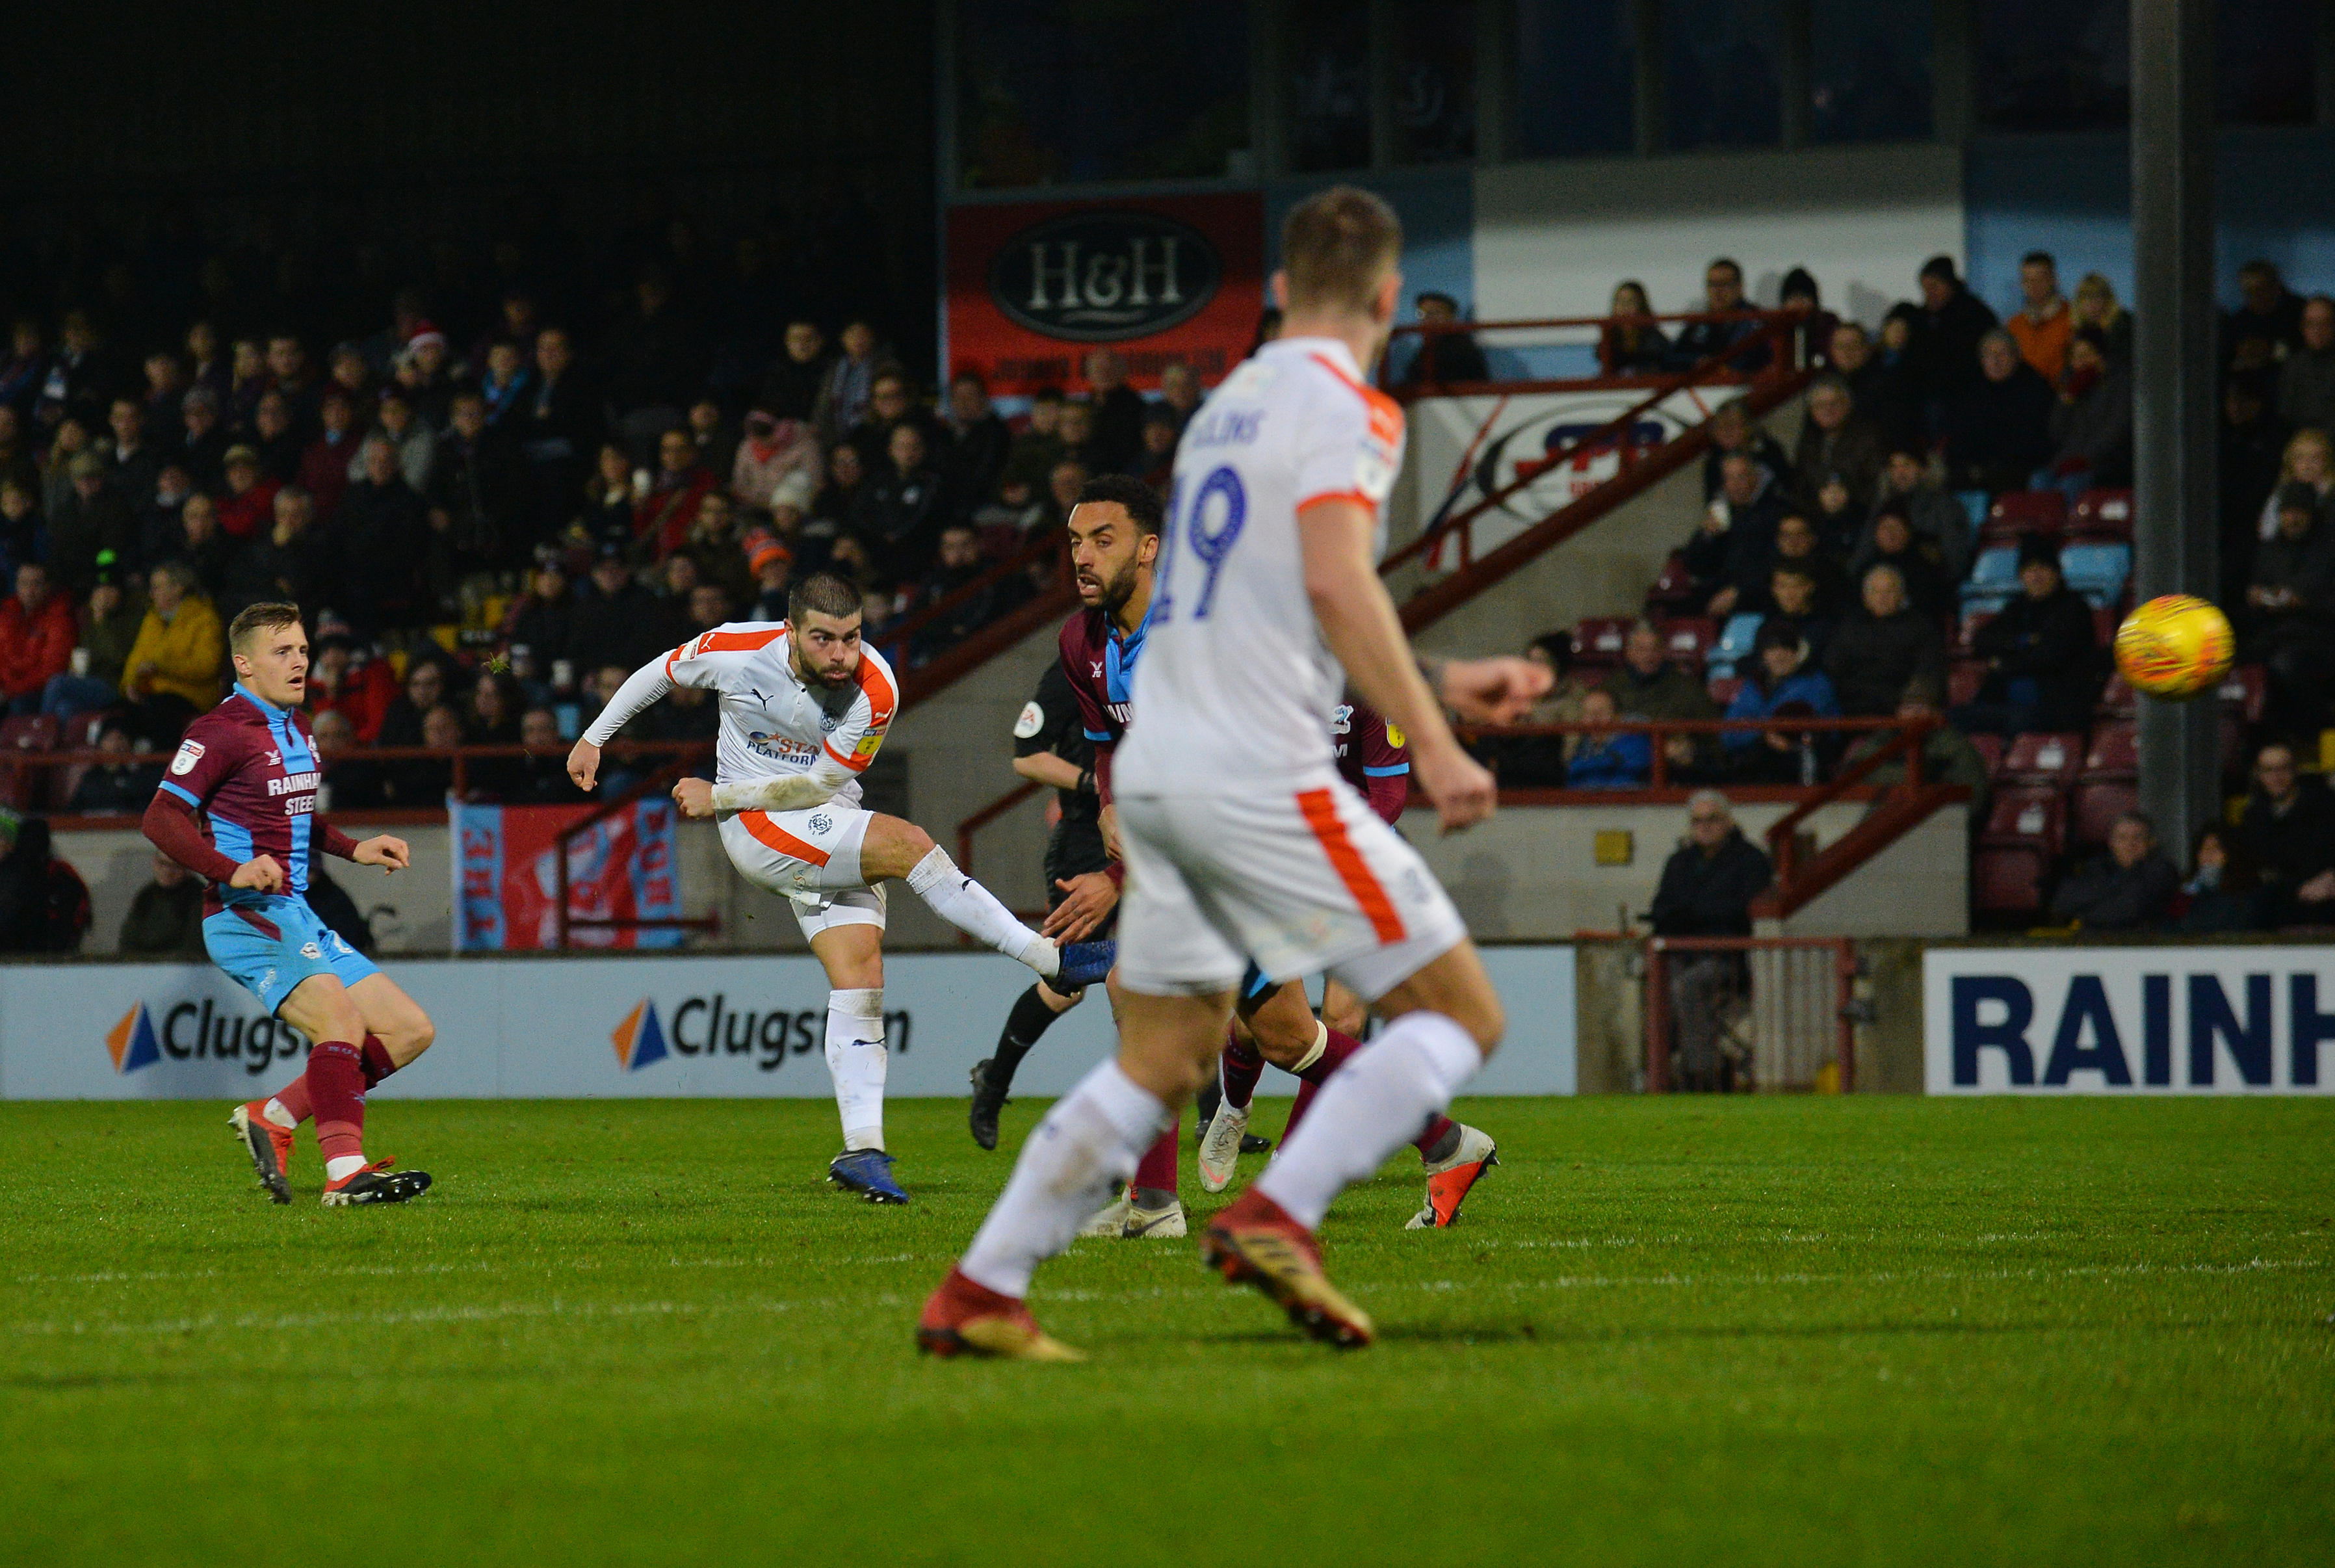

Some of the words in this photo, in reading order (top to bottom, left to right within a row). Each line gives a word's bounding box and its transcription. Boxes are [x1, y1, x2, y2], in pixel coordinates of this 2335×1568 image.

[1028, 236, 1184, 310] H&H
[1149, 464, 1246, 625] 19
[779, 738, 822, 755] STA
[267, 772, 321, 796] RAINHA
[284, 795, 316, 815] STEE
[672, 992, 910, 1071] Clugsn
[1951, 973, 2335, 1086] RAINH
